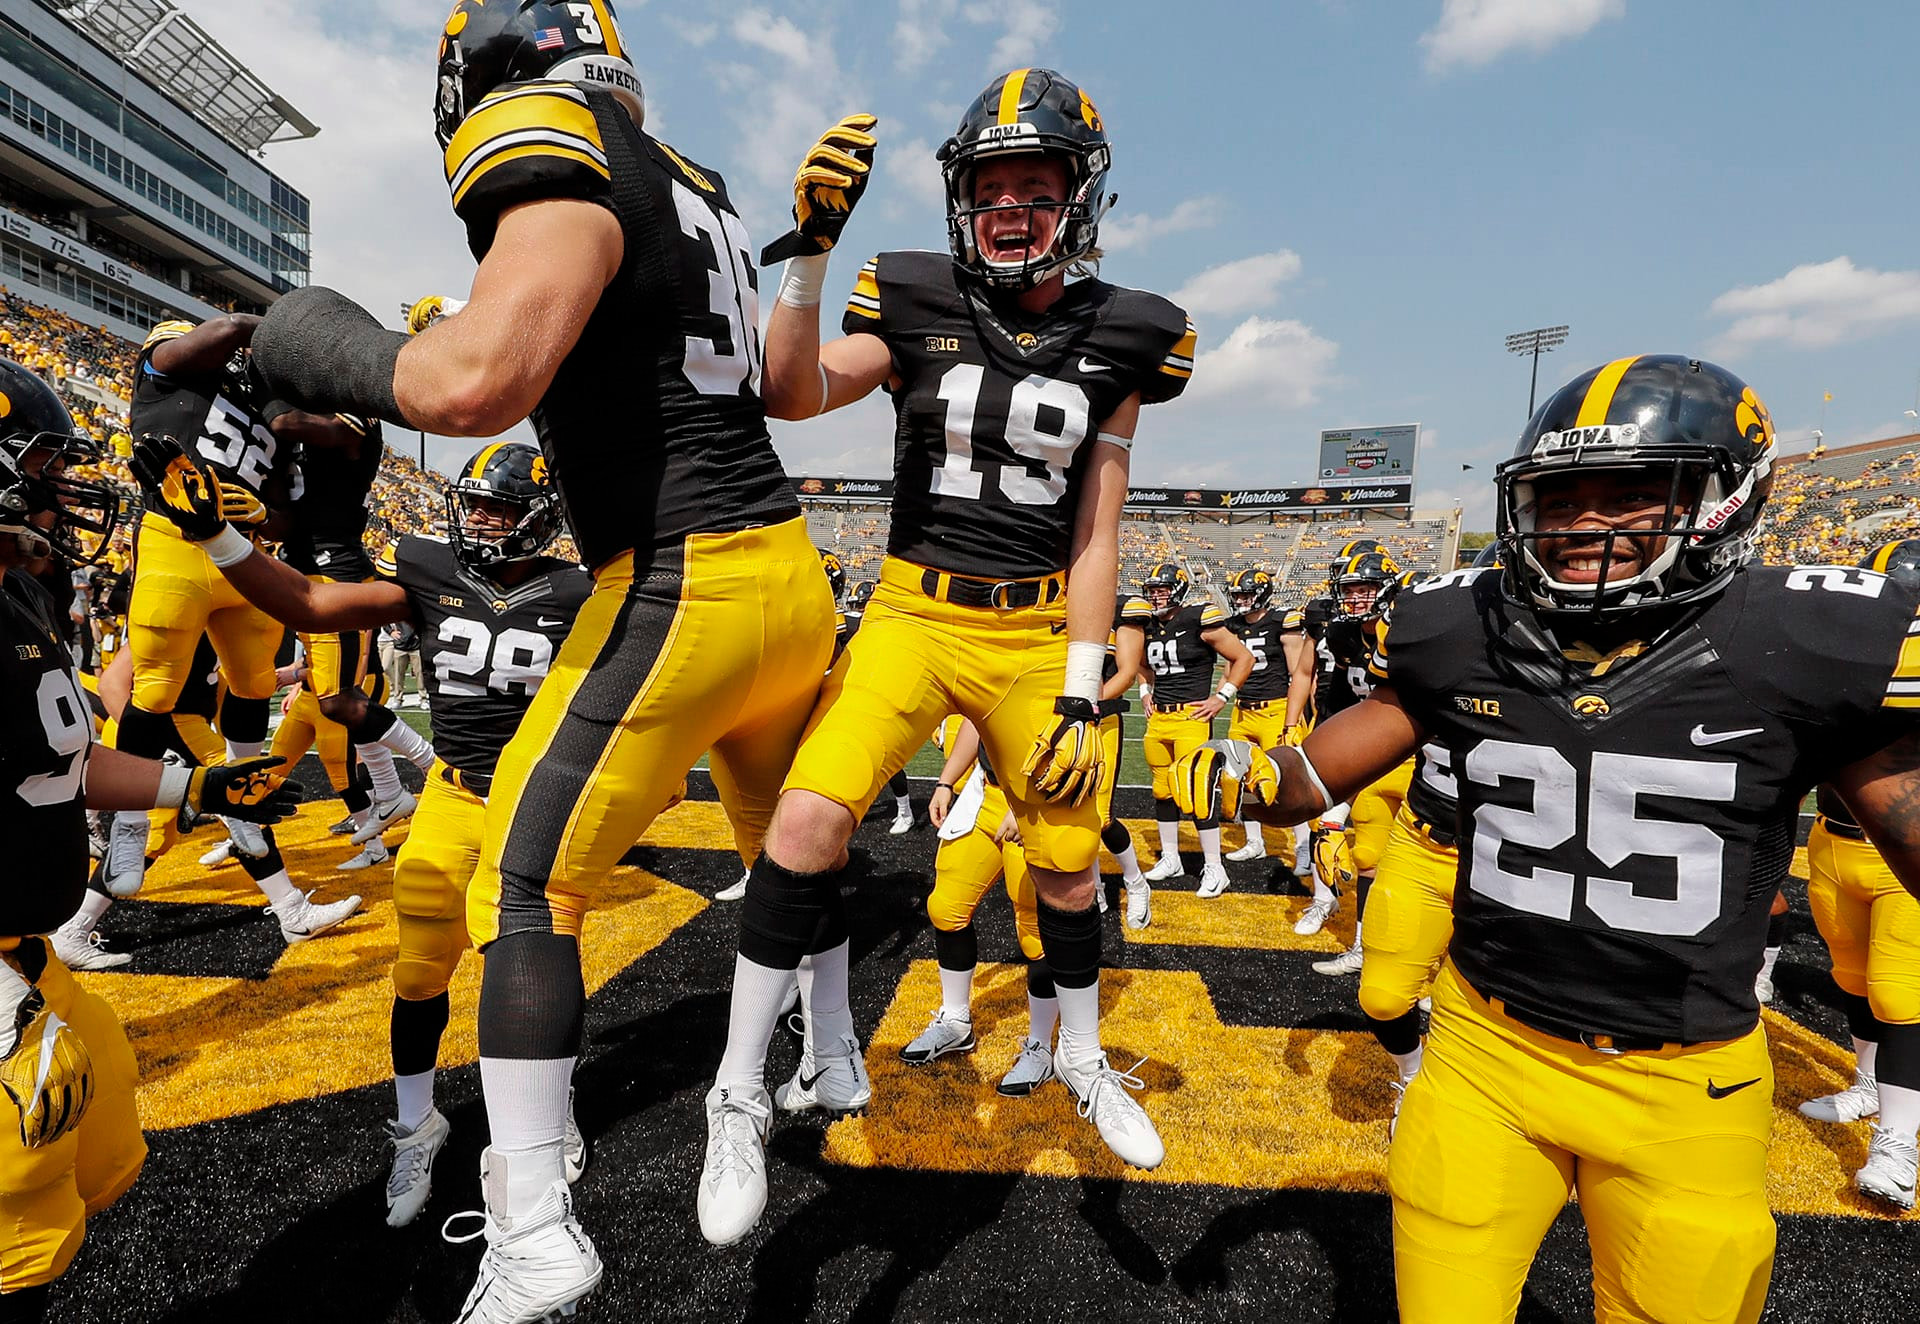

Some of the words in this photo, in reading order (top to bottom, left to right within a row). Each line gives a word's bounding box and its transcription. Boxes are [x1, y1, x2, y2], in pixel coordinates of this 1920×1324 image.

[567, 3, 603, 45] 3
[583, 63, 645, 99] HAWKEYE
[50, 236, 66, 253] 77
[102, 261, 115, 277] 16
[196, 393, 277, 491] 52
[929, 363, 1090, 504] 19
[1560, 427, 1613, 448] IOWA
[842, 482, 882, 492] Hardee's
[1128, 491, 1169, 501] Hardee's
[1229, 490, 1290, 505] Hardee's
[1350, 488, 1399, 501] Hardee's
[432, 616, 552, 696] 28
[1147, 640, 1186, 676] 81
[1240, 637, 1268, 671] 5
[16, 667, 97, 807] 9
[1466, 738, 1738, 936] 25
